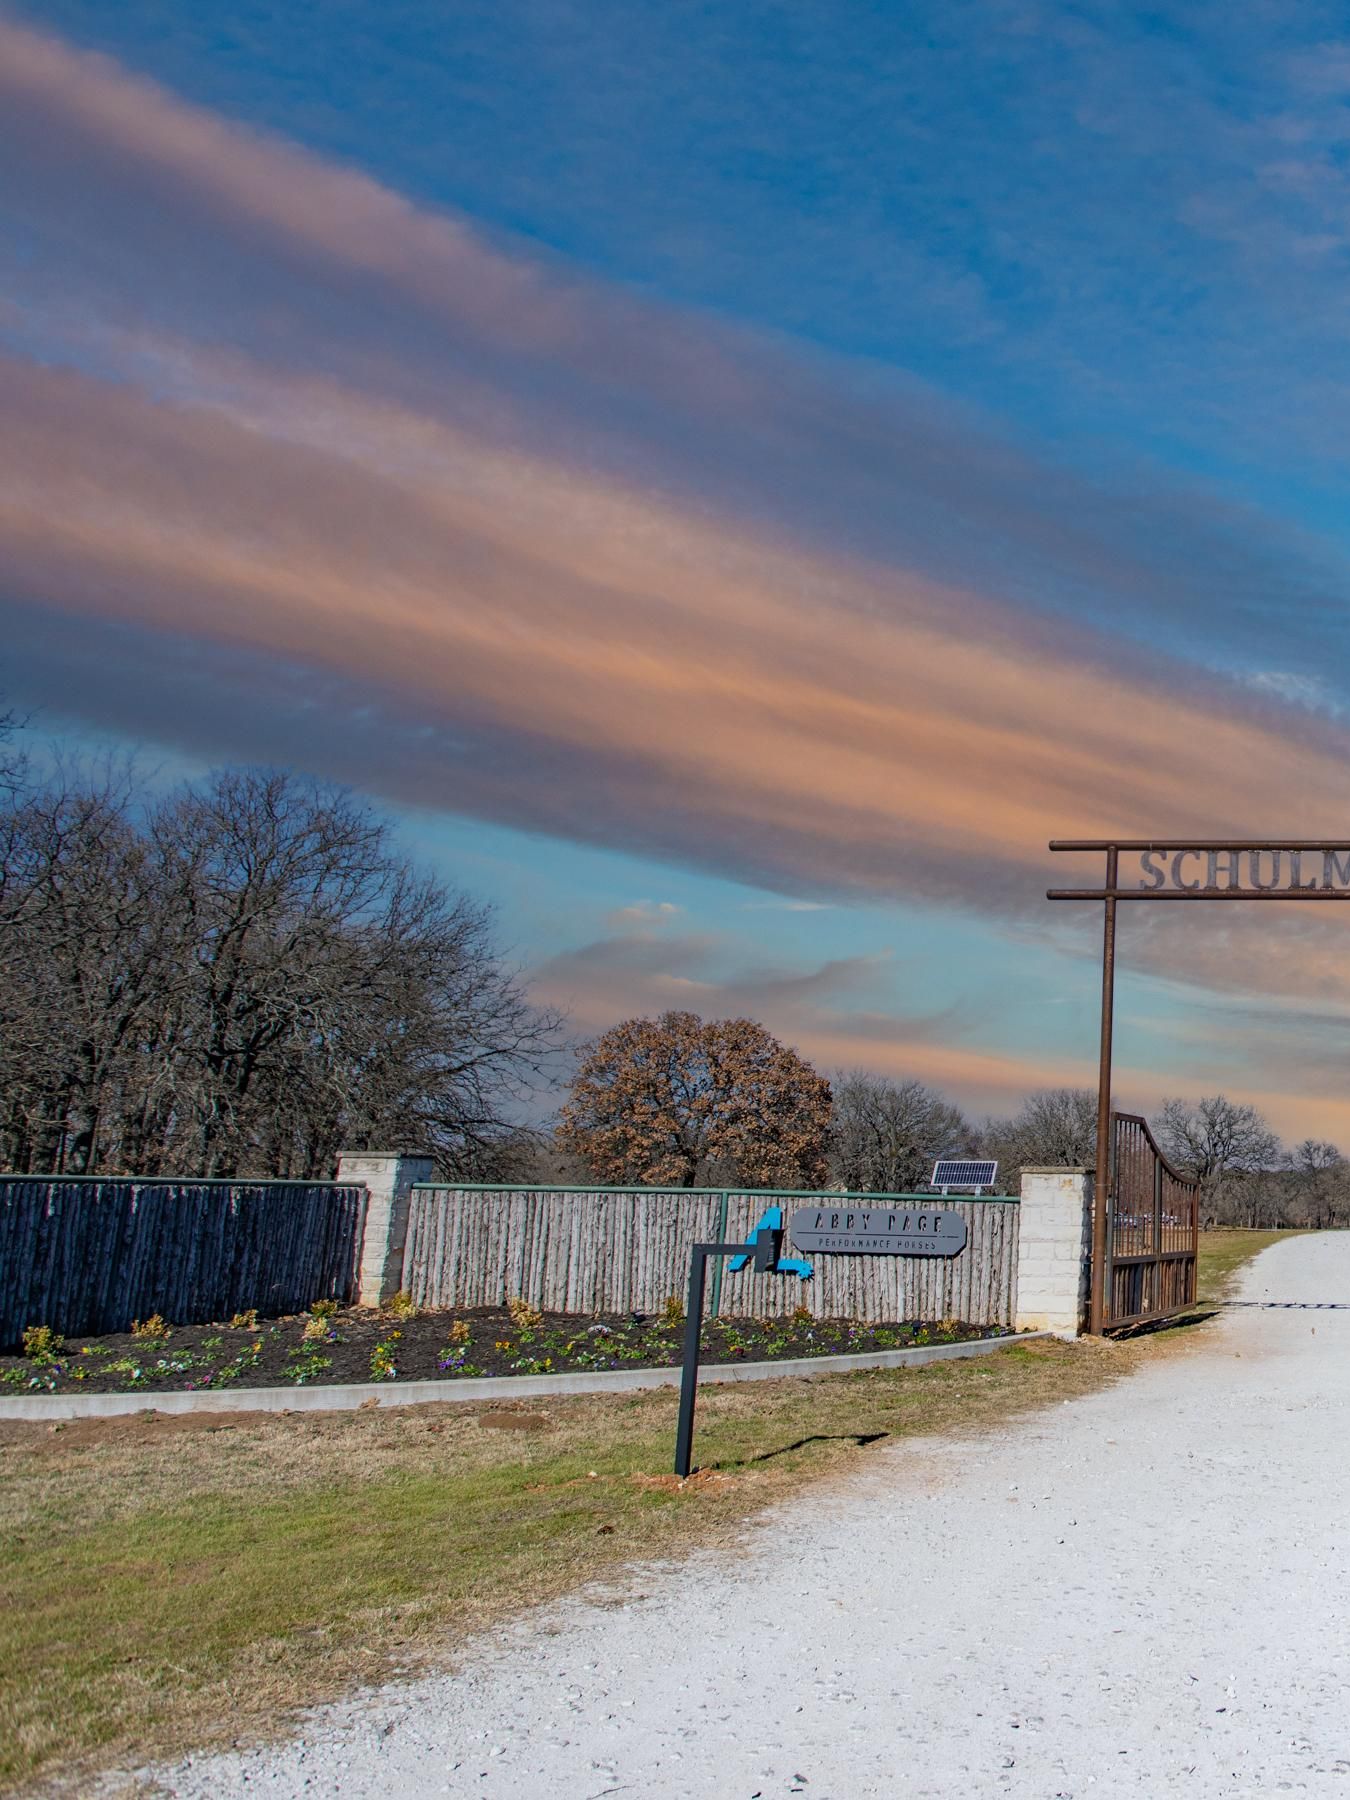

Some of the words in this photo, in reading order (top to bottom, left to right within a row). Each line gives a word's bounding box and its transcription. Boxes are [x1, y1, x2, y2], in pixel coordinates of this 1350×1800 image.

[814, 1212, 871, 1231] ABBY
[887, 1214, 943, 1233] PAGE
[818, 1237, 891, 1249] PERFORMANCE
[897, 1239, 937, 1250] HORSES
